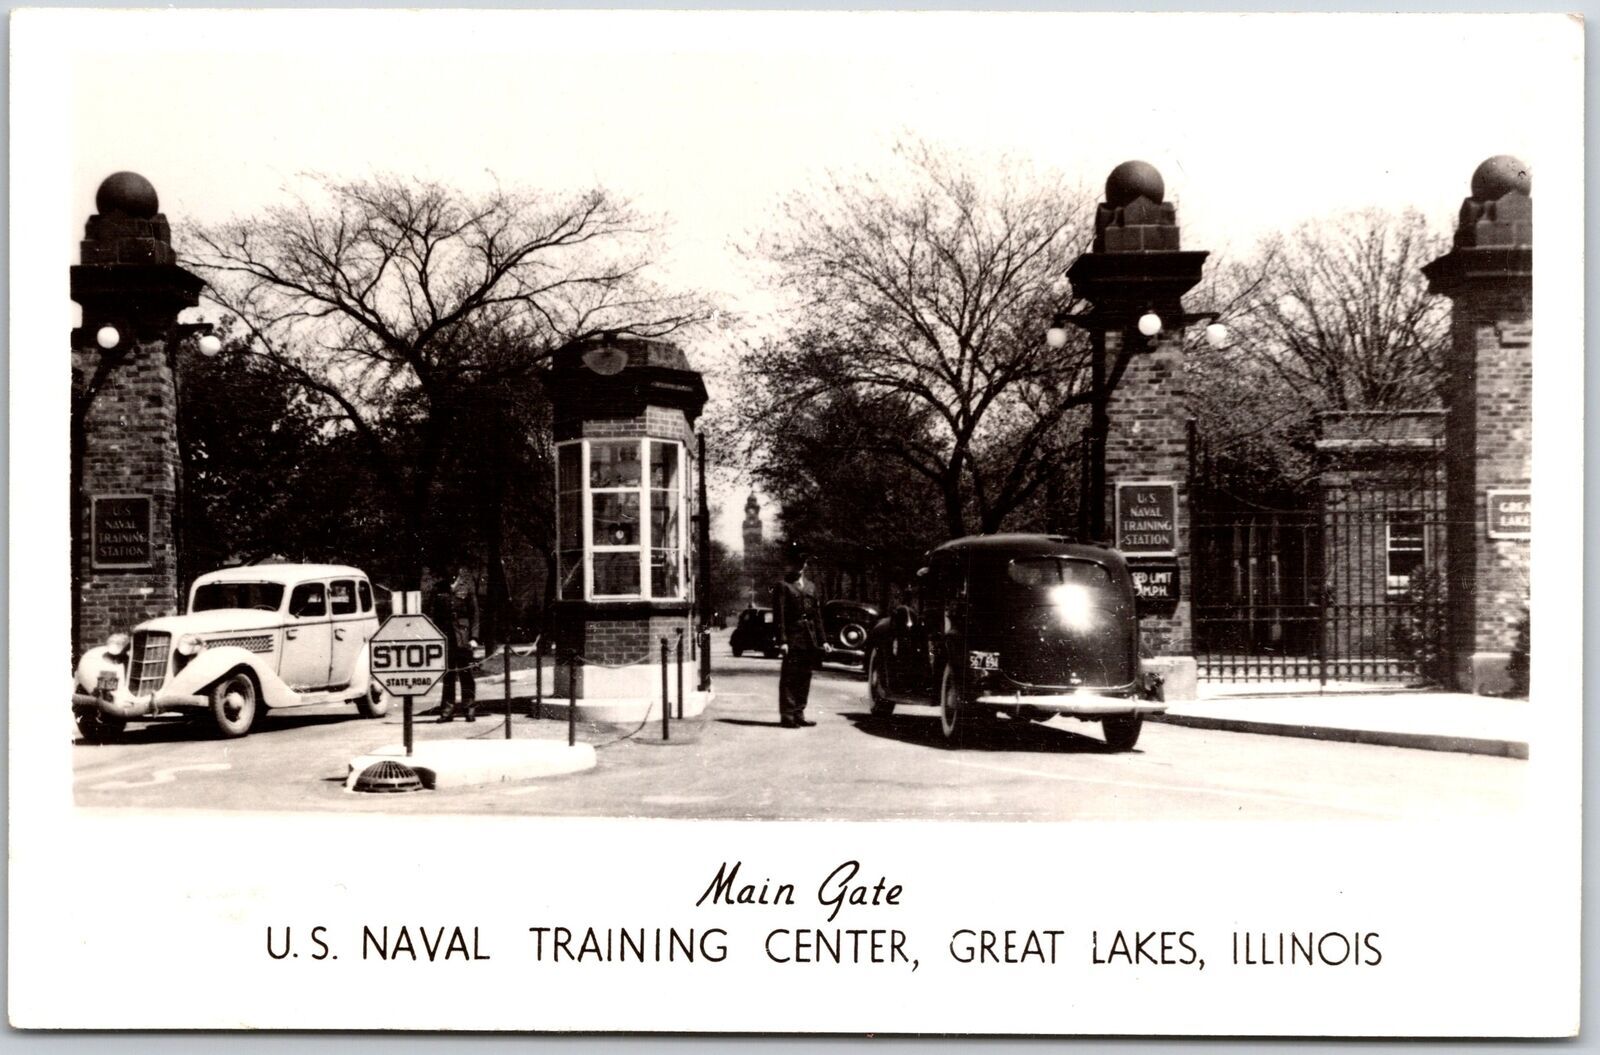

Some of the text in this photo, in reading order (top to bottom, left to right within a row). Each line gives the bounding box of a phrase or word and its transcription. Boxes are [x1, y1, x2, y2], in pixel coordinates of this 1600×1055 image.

[1130, 507, 1163, 517] NAVAL
[1500, 502, 1531, 513] GREA
[105, 520, 137, 529] NAVAL
[1123, 520, 1172, 531] TRAINING
[1500, 515, 1530, 526] LAKE
[99, 532, 149, 544] TRAINING
[1124, 534, 1170, 546] STATION
[100, 546, 146, 558] STATION
[1149, 571, 1173, 584] LIMIT
[373, 644, 443, 669] STOP
[386, 677, 432, 687] STATE ROAD
